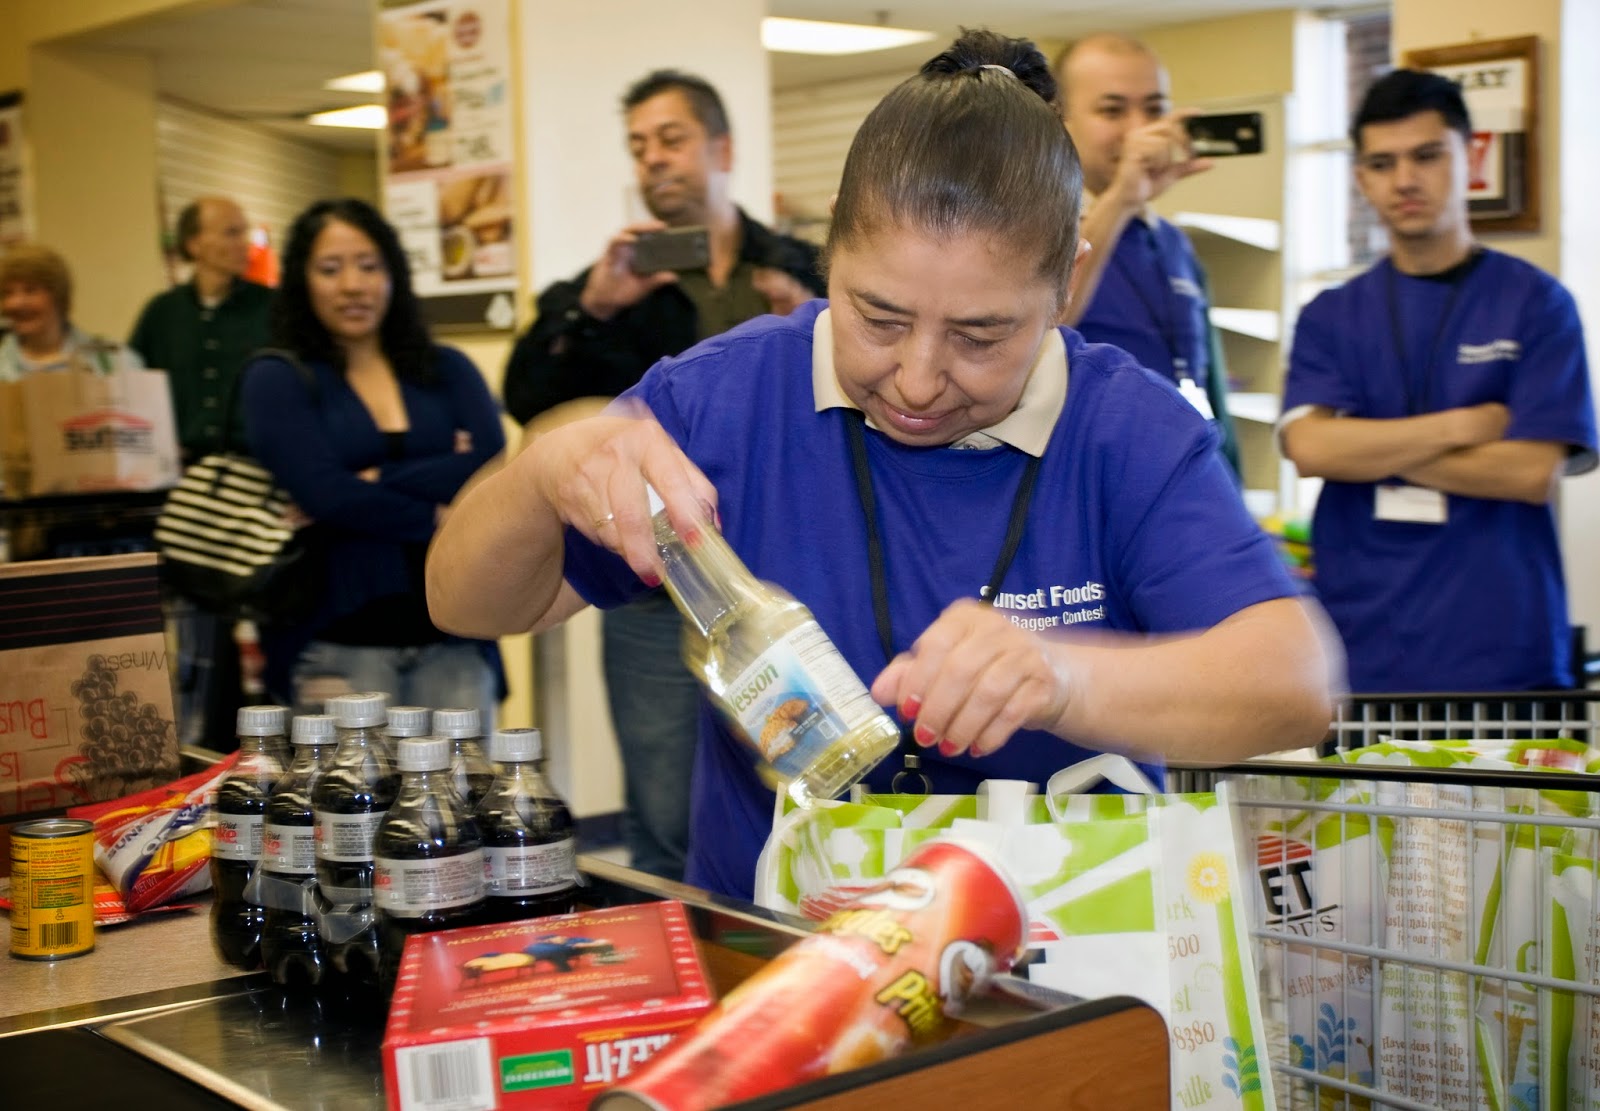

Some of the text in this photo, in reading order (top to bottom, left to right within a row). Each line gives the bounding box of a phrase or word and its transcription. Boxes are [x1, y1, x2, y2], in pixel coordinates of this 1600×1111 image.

[1050, 581, 1105, 607] Foods
[1011, 605, 1105, 632] Bagger Contest
[1382, 1036, 1406, 1050] Have
[1407, 1038, 1431, 1053] deas
[1450, 1058, 1465, 1072] the
[1177, 1074, 1213, 1109] ville
